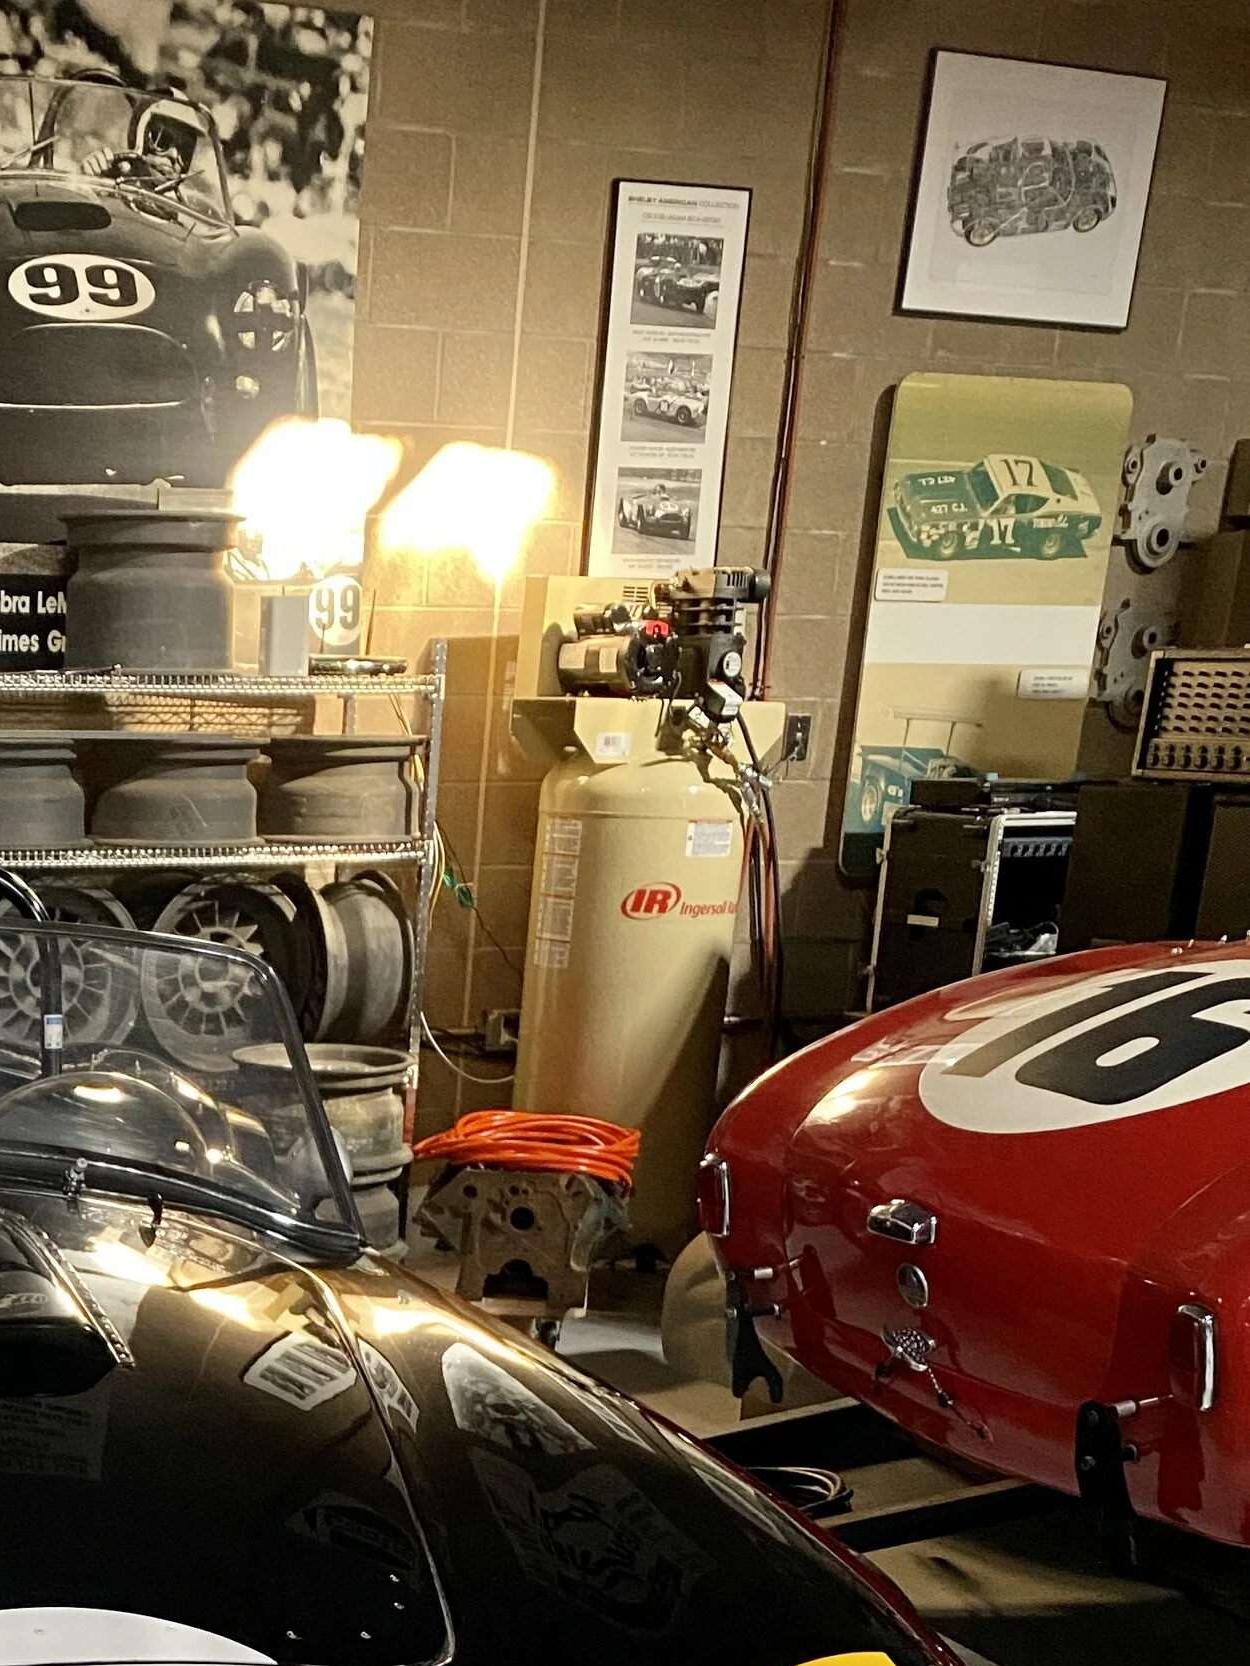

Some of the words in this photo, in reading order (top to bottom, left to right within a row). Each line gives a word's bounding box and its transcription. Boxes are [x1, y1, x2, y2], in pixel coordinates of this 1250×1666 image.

[628, 195, 657, 204] SHELBY
[658, 198, 698, 206] AMERICAN
[24, 262, 138, 307] 99
[999, 458, 1039, 488] 17
[988, 516, 1017, 545] 17
[315, 584, 360, 630] 99
[629, 888, 672, 914] IR
[940, 971, 1250, 1106] 16
